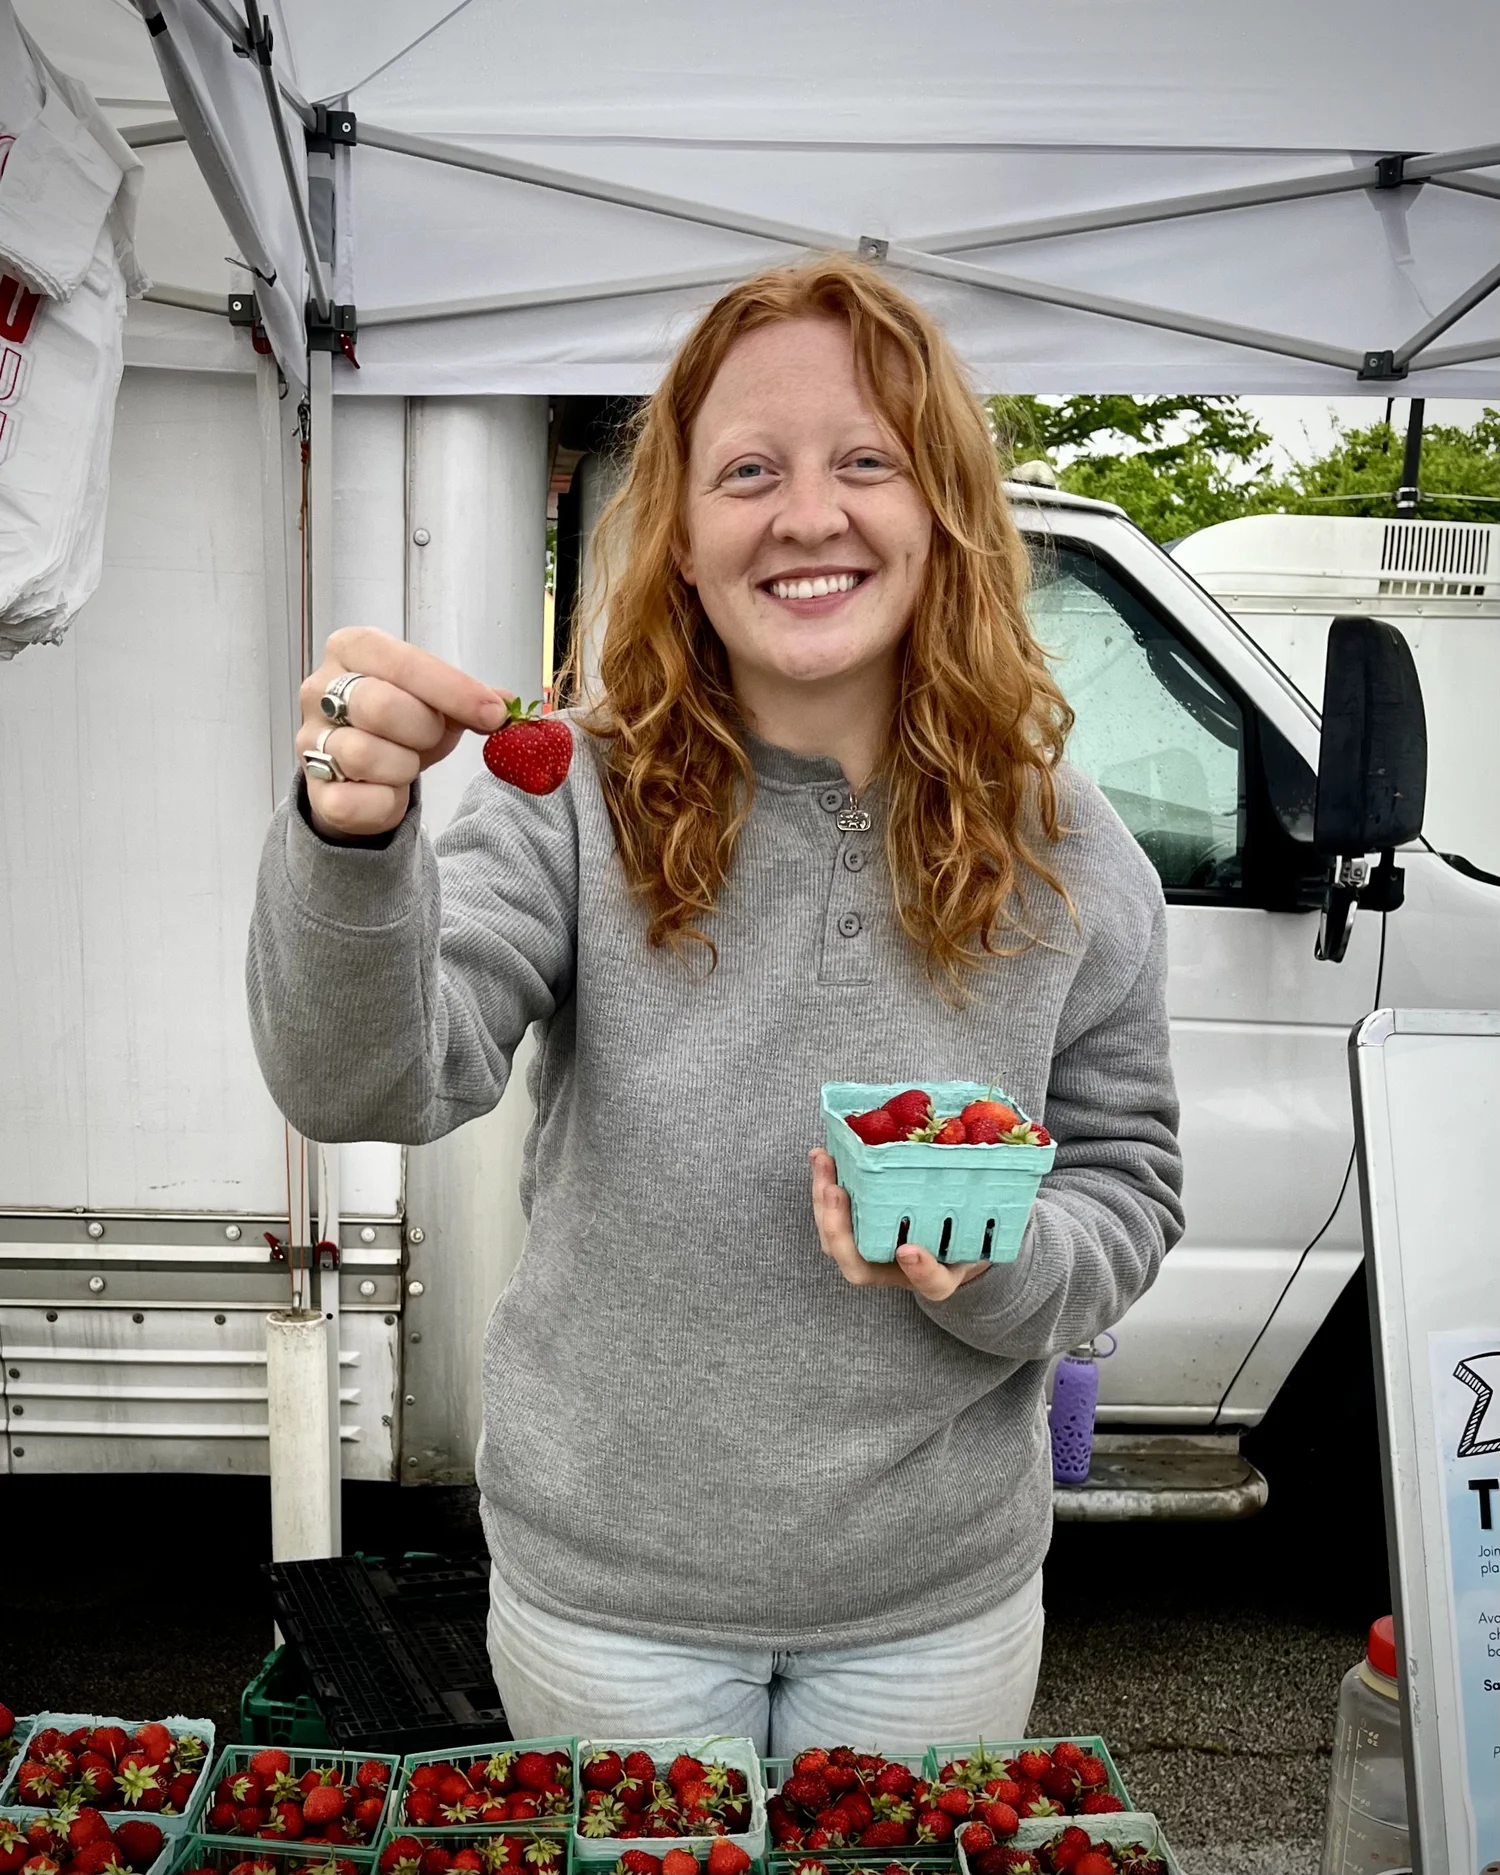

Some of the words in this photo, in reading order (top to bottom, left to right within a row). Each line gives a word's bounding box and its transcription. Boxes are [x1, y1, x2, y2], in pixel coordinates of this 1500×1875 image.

[1468, 1478, 1500, 1530] T
[1478, 1545, 1500, 1558] Join
[1481, 1560, 1500, 1578] pla
